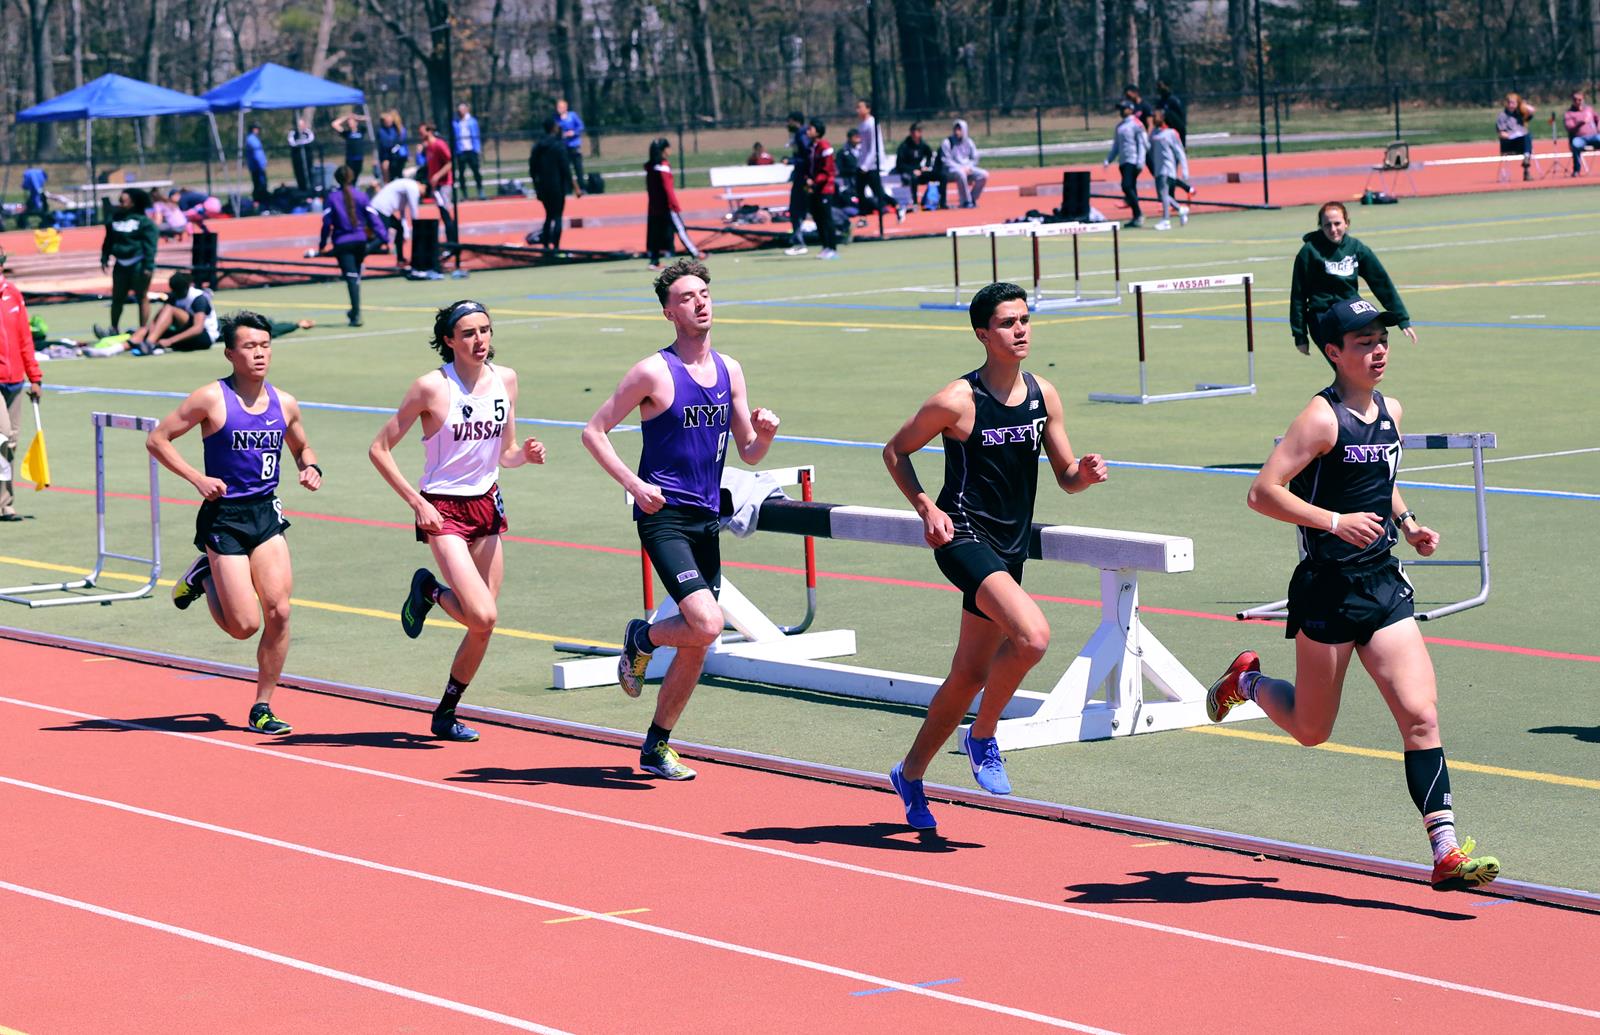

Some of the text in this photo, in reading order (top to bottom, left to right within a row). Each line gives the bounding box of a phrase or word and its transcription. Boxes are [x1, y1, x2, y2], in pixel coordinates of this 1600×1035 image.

[1172, 279, 1211, 289] VASSAR
[494, 399, 506, 422] 5
[683, 402, 729, 429] NYU
[232, 430, 282, 450] NYU
[452, 420, 505, 442] VASSA
[264, 455, 274, 478] 3
[1388, 444, 1400, 475] 7
